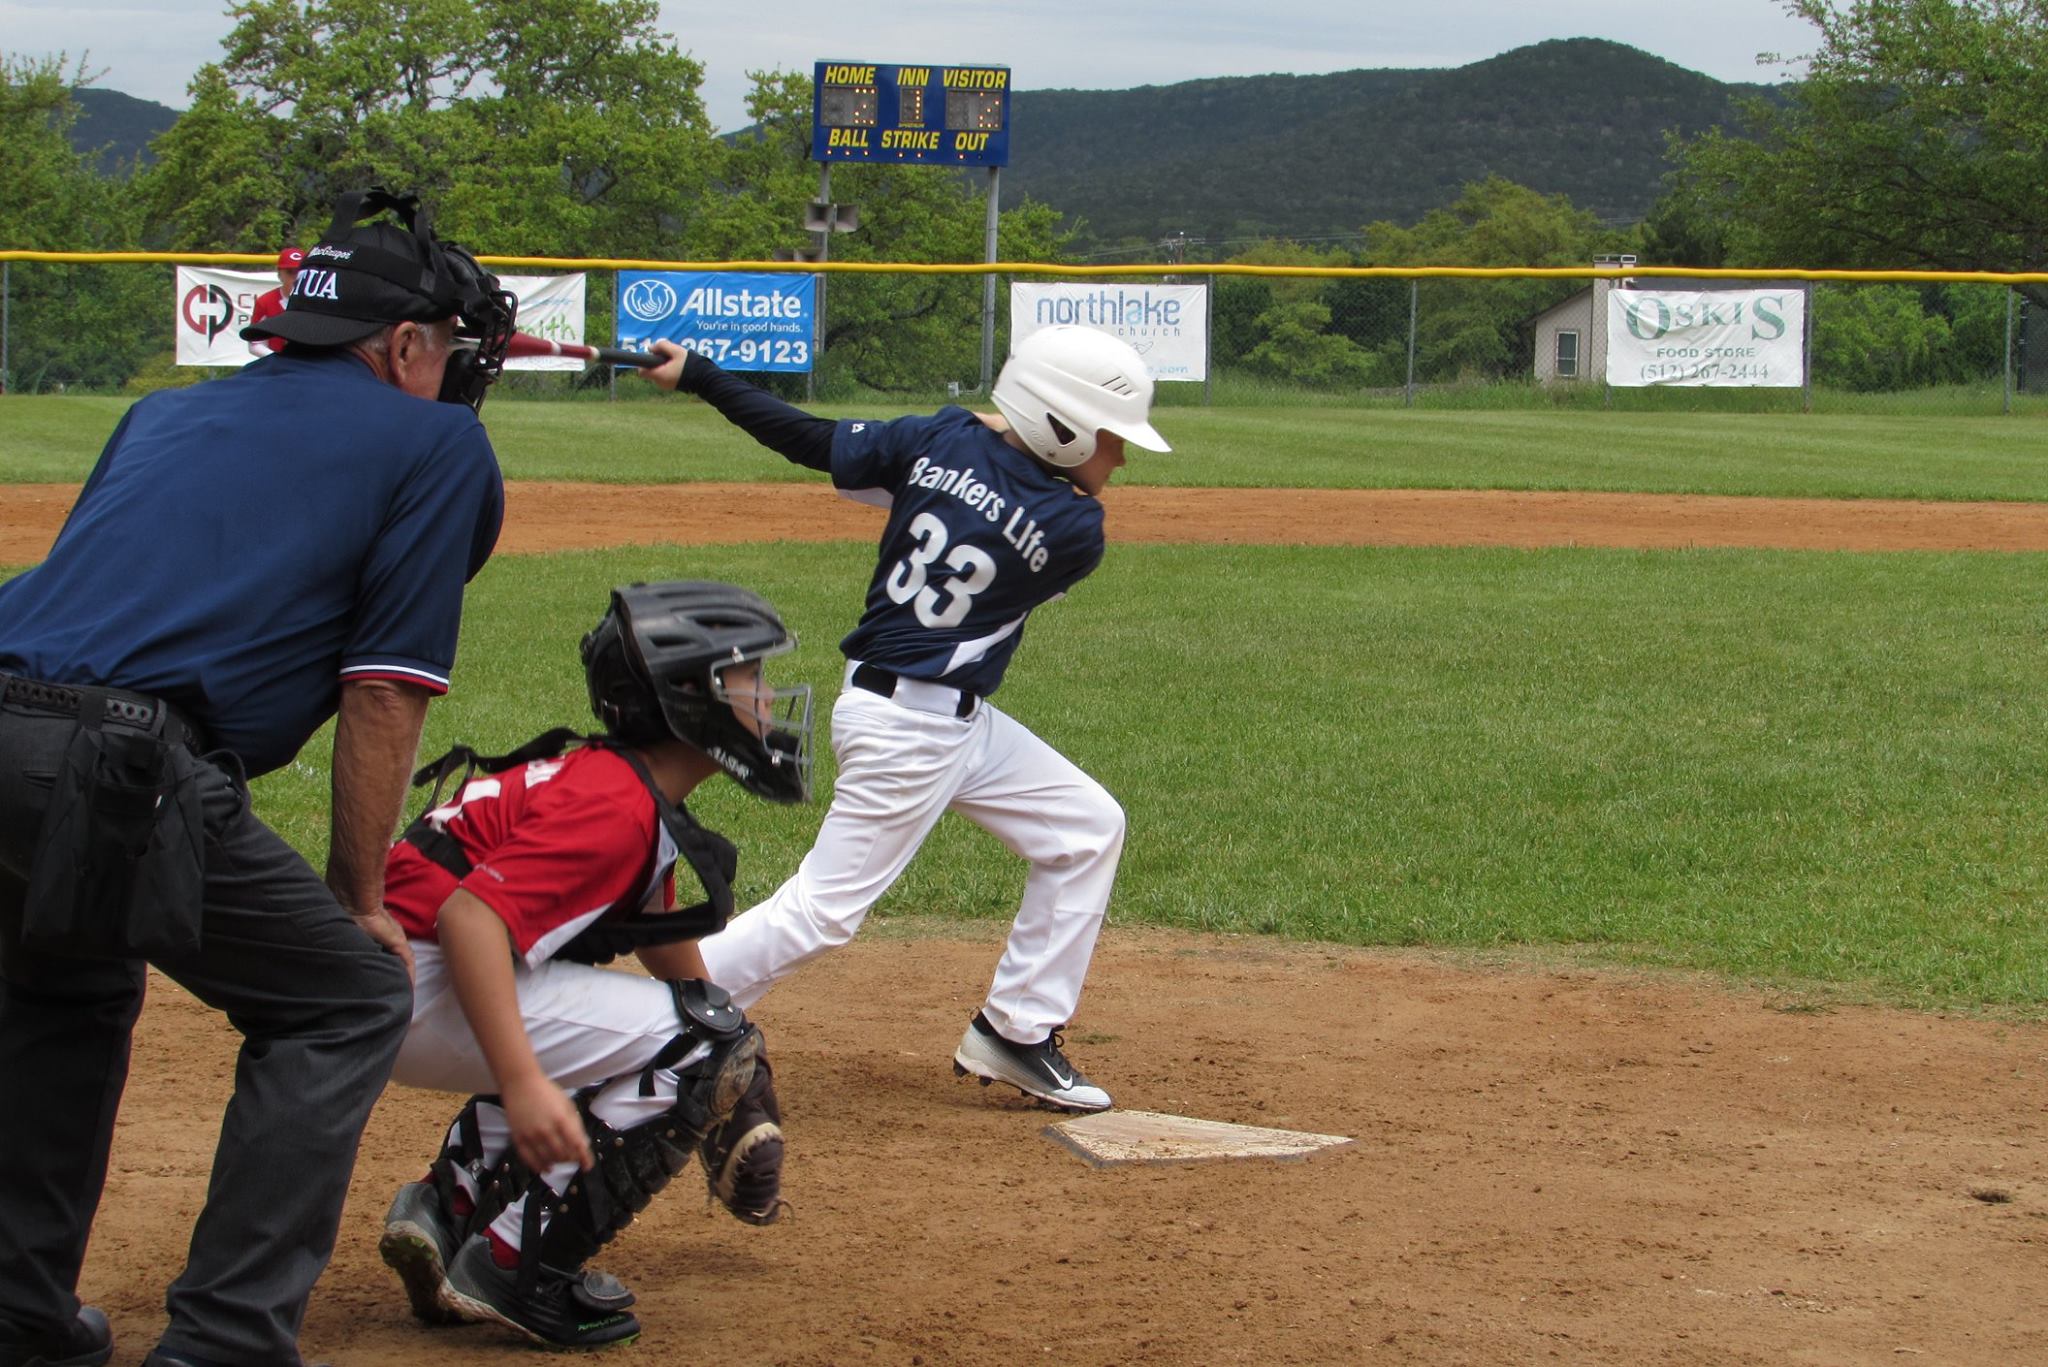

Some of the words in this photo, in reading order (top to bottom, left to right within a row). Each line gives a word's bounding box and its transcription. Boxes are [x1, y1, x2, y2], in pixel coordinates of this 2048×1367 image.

[825, 65, 876, 84] HOME
[897, 68, 930, 86] INN
[943, 69, 1007, 88] VISITOR
[828, 128, 869, 147] BALL
[881, 130, 940, 149] STRIKE
[955, 132, 989, 151] OUT
[290, 269, 338, 299] TUA
[680, 288, 801, 317] Allstate
[1036, 290, 1181, 326] northlake
[696, 320, 728, 330] You're
[731, 321, 740, 331] in
[742, 322, 768, 334] good
[770, 323, 803, 333] hands.
[1118, 326, 1180, 337] church
[1657, 348, 1699, 358] FOOD
[1705, 348, 1755, 358] STORE
[1640, 364, 1684, 381] (512)
[1690, 363, 1769, 379] 267-2444
[907, 457, 1005, 522] Bankers
[886, 512, 997, 628] 33
